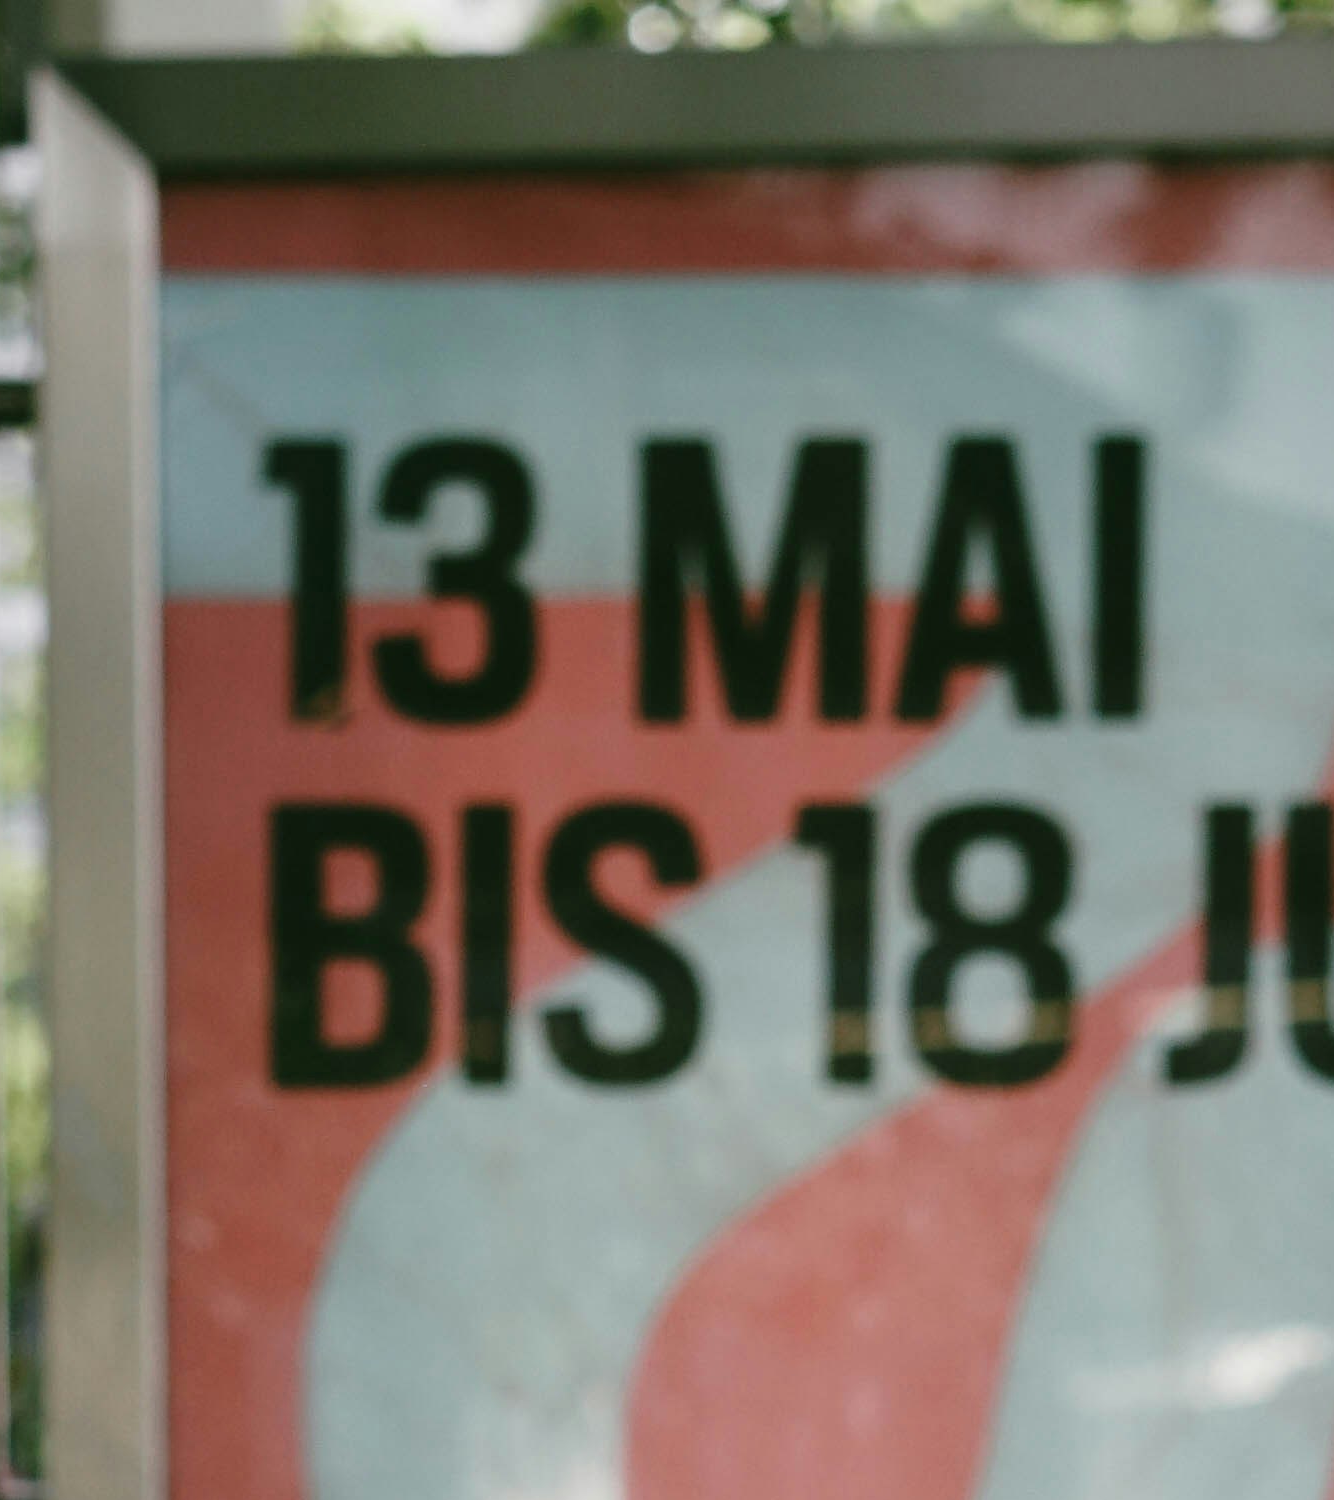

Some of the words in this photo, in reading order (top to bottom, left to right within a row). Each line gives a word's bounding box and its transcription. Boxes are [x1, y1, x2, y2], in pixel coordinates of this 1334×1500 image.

[261, 436, 538, 726] 13
[635, 436, 1149, 726] MAI
[267, 802, 707, 1091] BIS
[789, 802, 1079, 1091] 18
